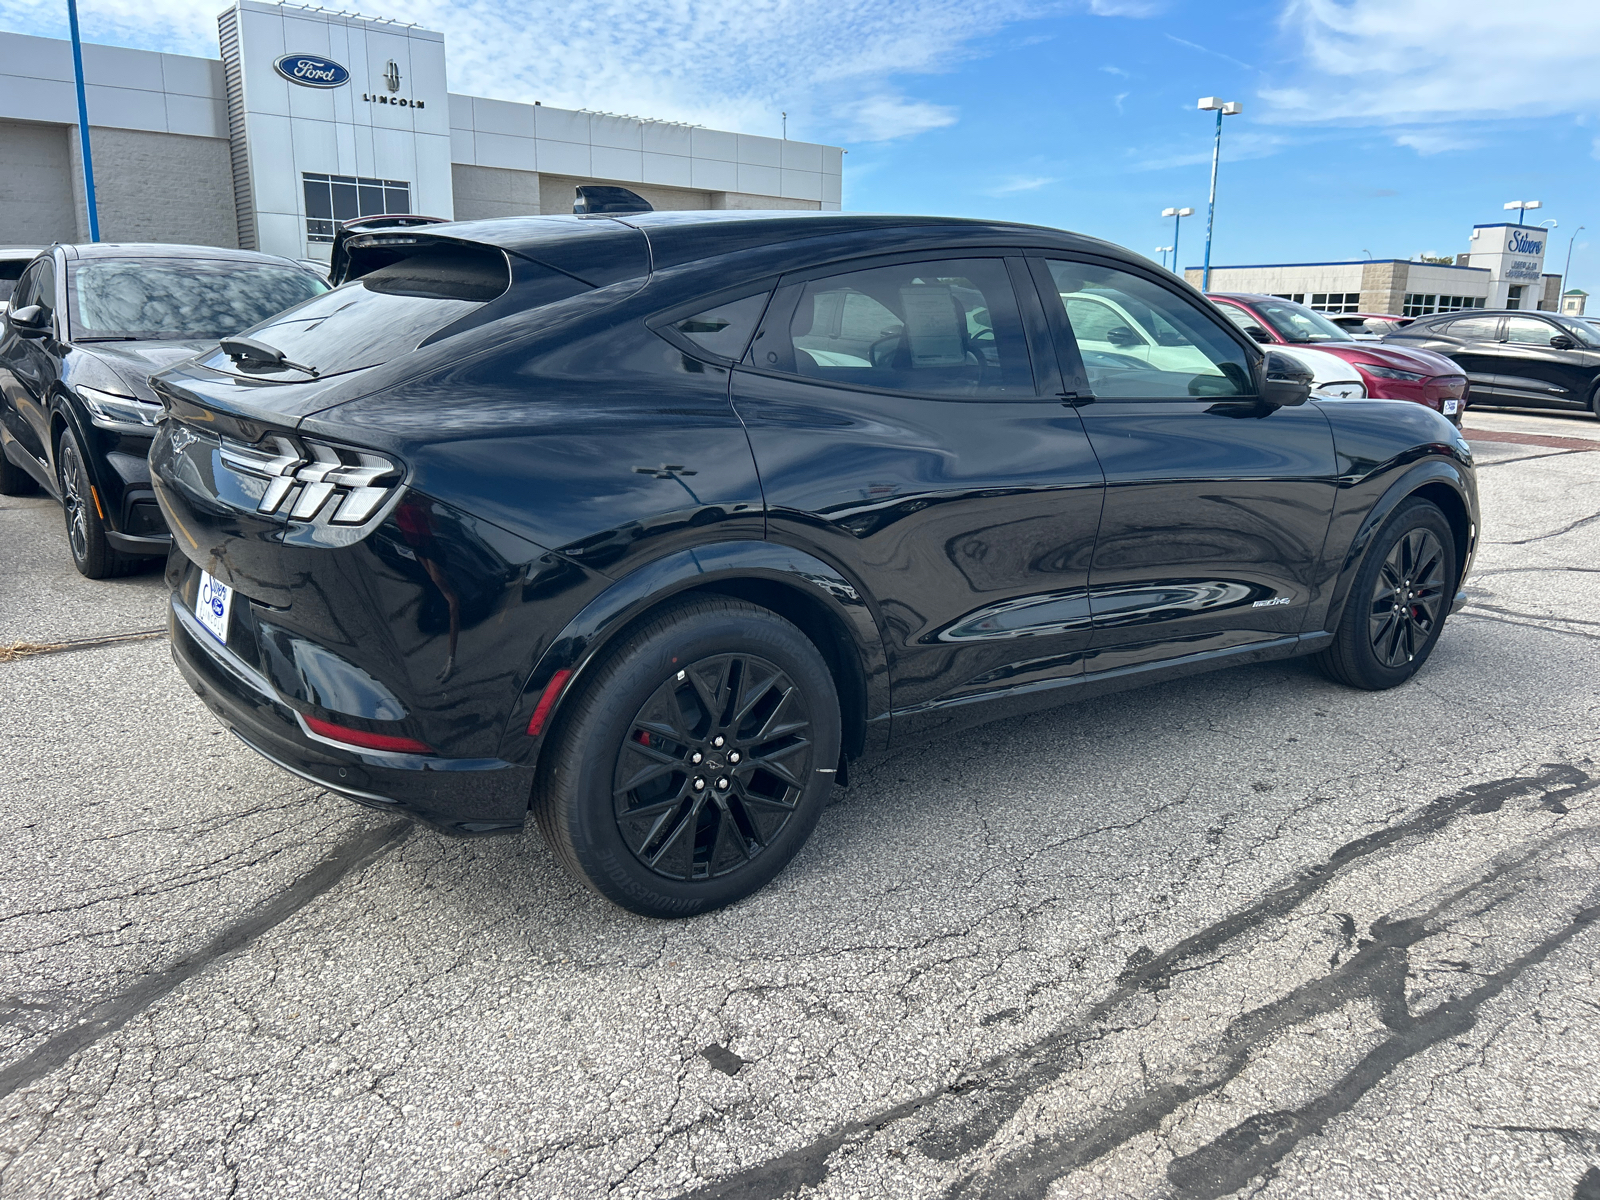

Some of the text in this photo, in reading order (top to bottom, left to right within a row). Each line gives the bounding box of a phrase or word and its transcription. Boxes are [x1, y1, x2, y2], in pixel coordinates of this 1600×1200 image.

[293, 59, 335, 82] Ford
[363, 93, 425, 109] LINCOLN
[1508, 230, 1543, 254] Stivers
[595, 848, 705, 914] BRIDGESTONE
